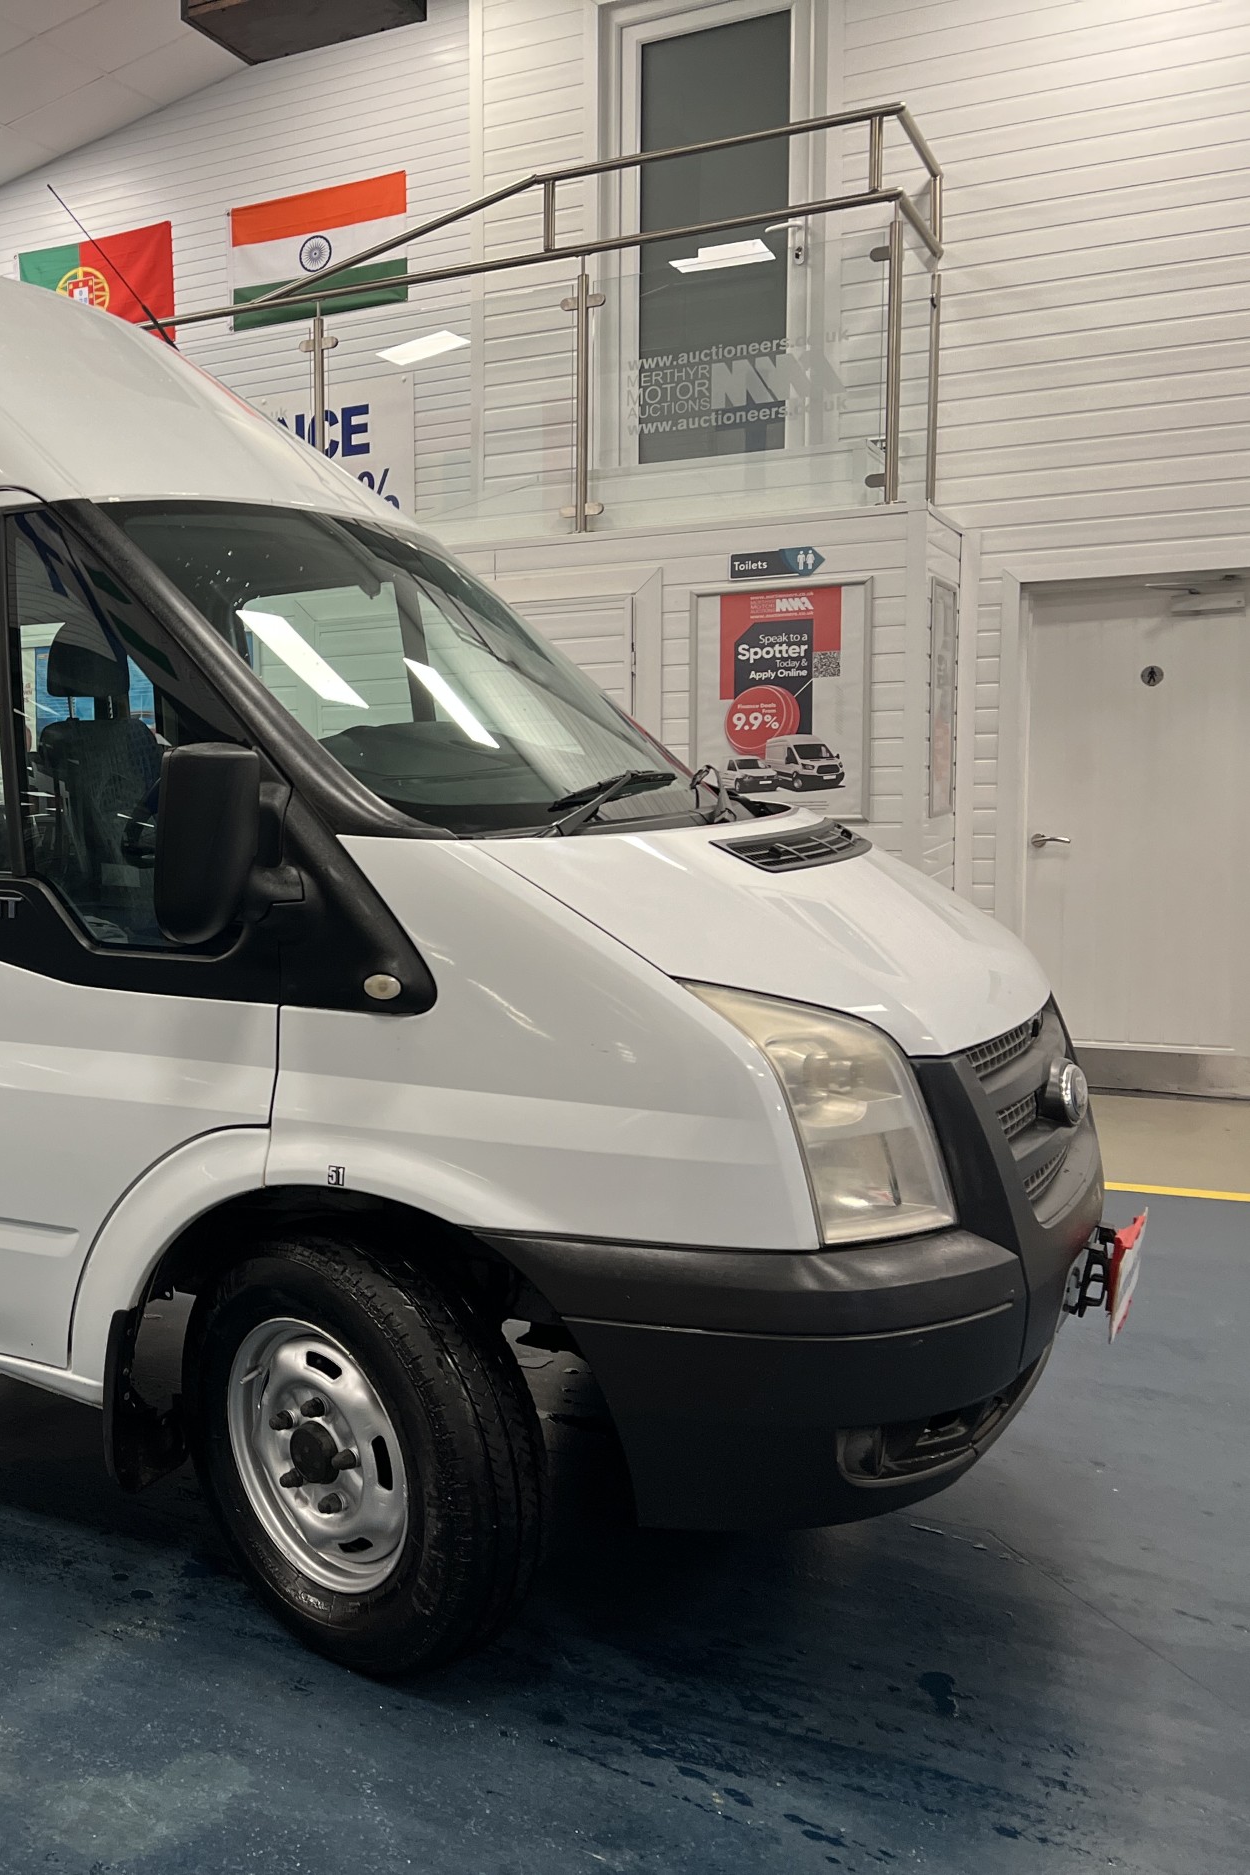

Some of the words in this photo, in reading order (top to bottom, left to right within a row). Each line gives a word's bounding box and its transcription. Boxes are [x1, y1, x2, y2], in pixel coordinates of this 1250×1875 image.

[628, 365, 709, 387] MERTHYR
[627, 379, 709, 405] MOTOR
[628, 398, 710, 419] AUCTIONS
[734, 560, 767, 571] Toilets
[759, 634, 788, 645] Speak
[790, 634, 799, 642] to
[737, 643, 808, 663] Spotter
[775, 659, 799, 669] Today
[749, 670, 775, 680] Apply
[777, 668, 807, 677] Online
[733, 712, 779, 730] 9.9%
[328, 1166, 345, 1185] 51
